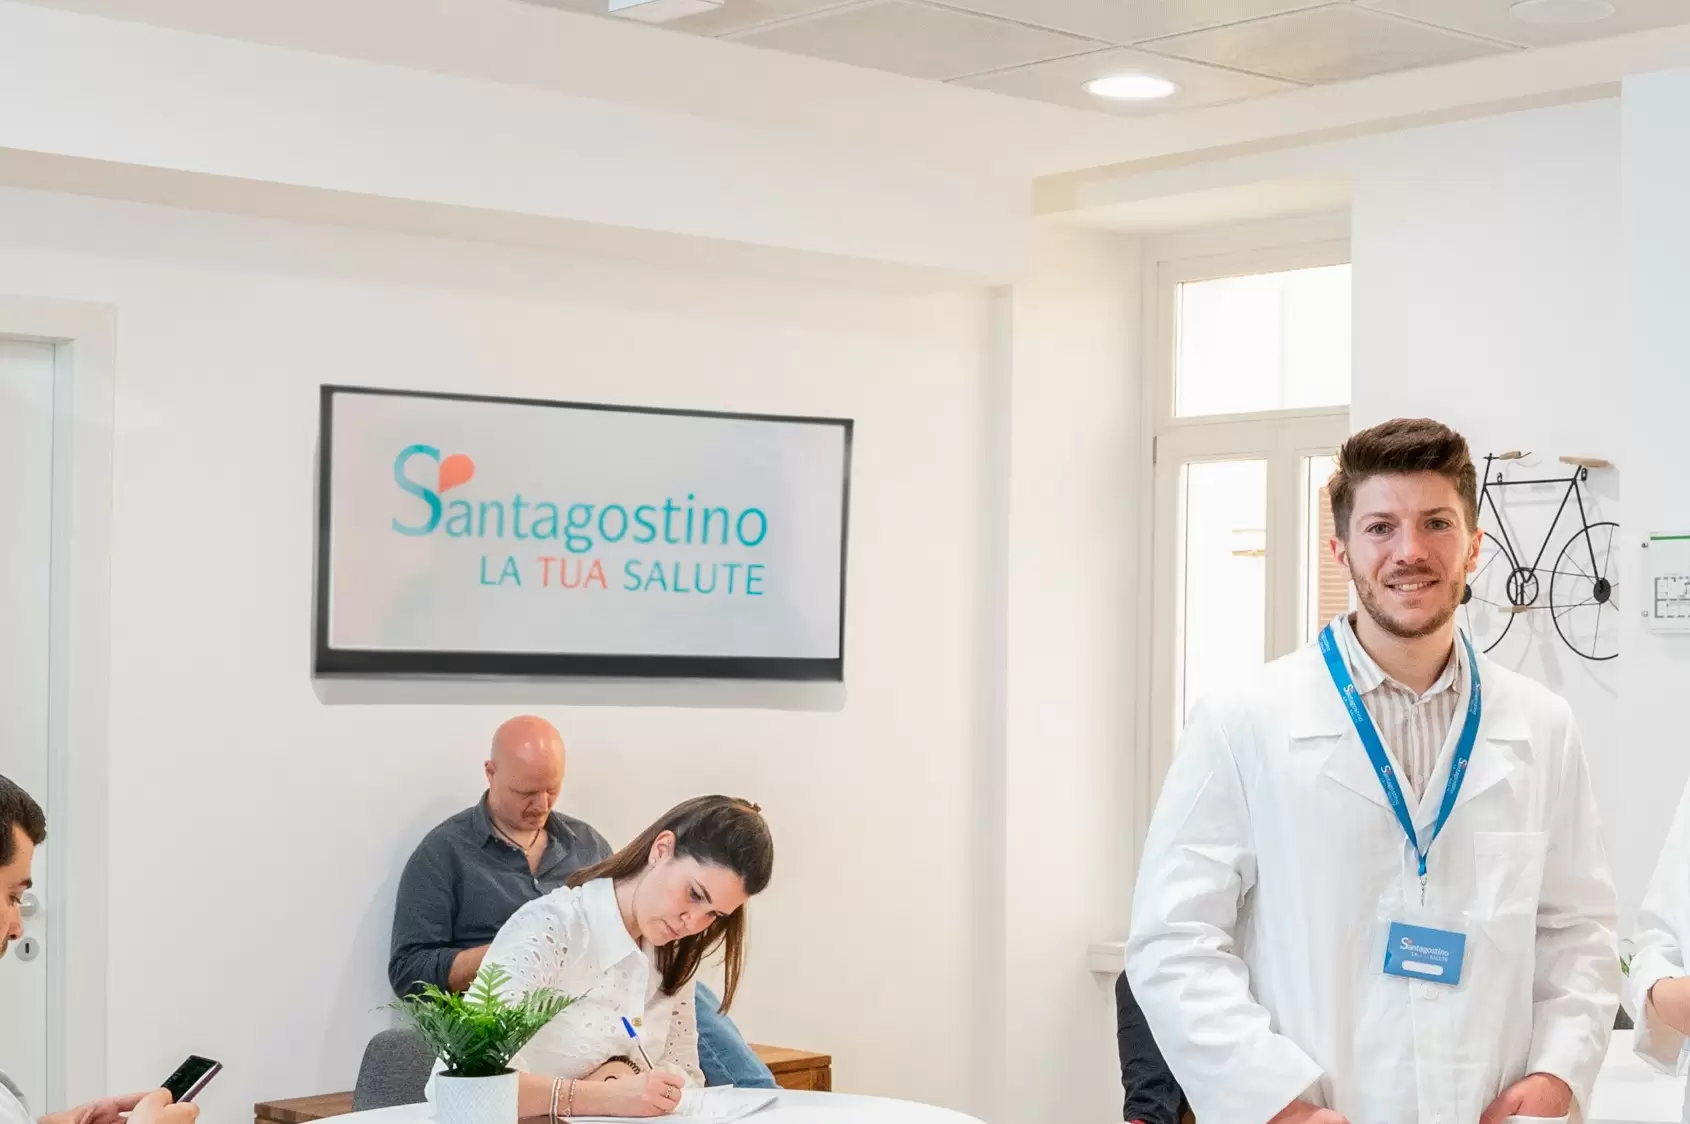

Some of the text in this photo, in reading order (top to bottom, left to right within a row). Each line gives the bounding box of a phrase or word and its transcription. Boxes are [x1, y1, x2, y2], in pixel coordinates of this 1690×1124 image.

[391, 443, 768, 553] Santagostino
[480, 555, 765, 595] LA TUA SALUTE
